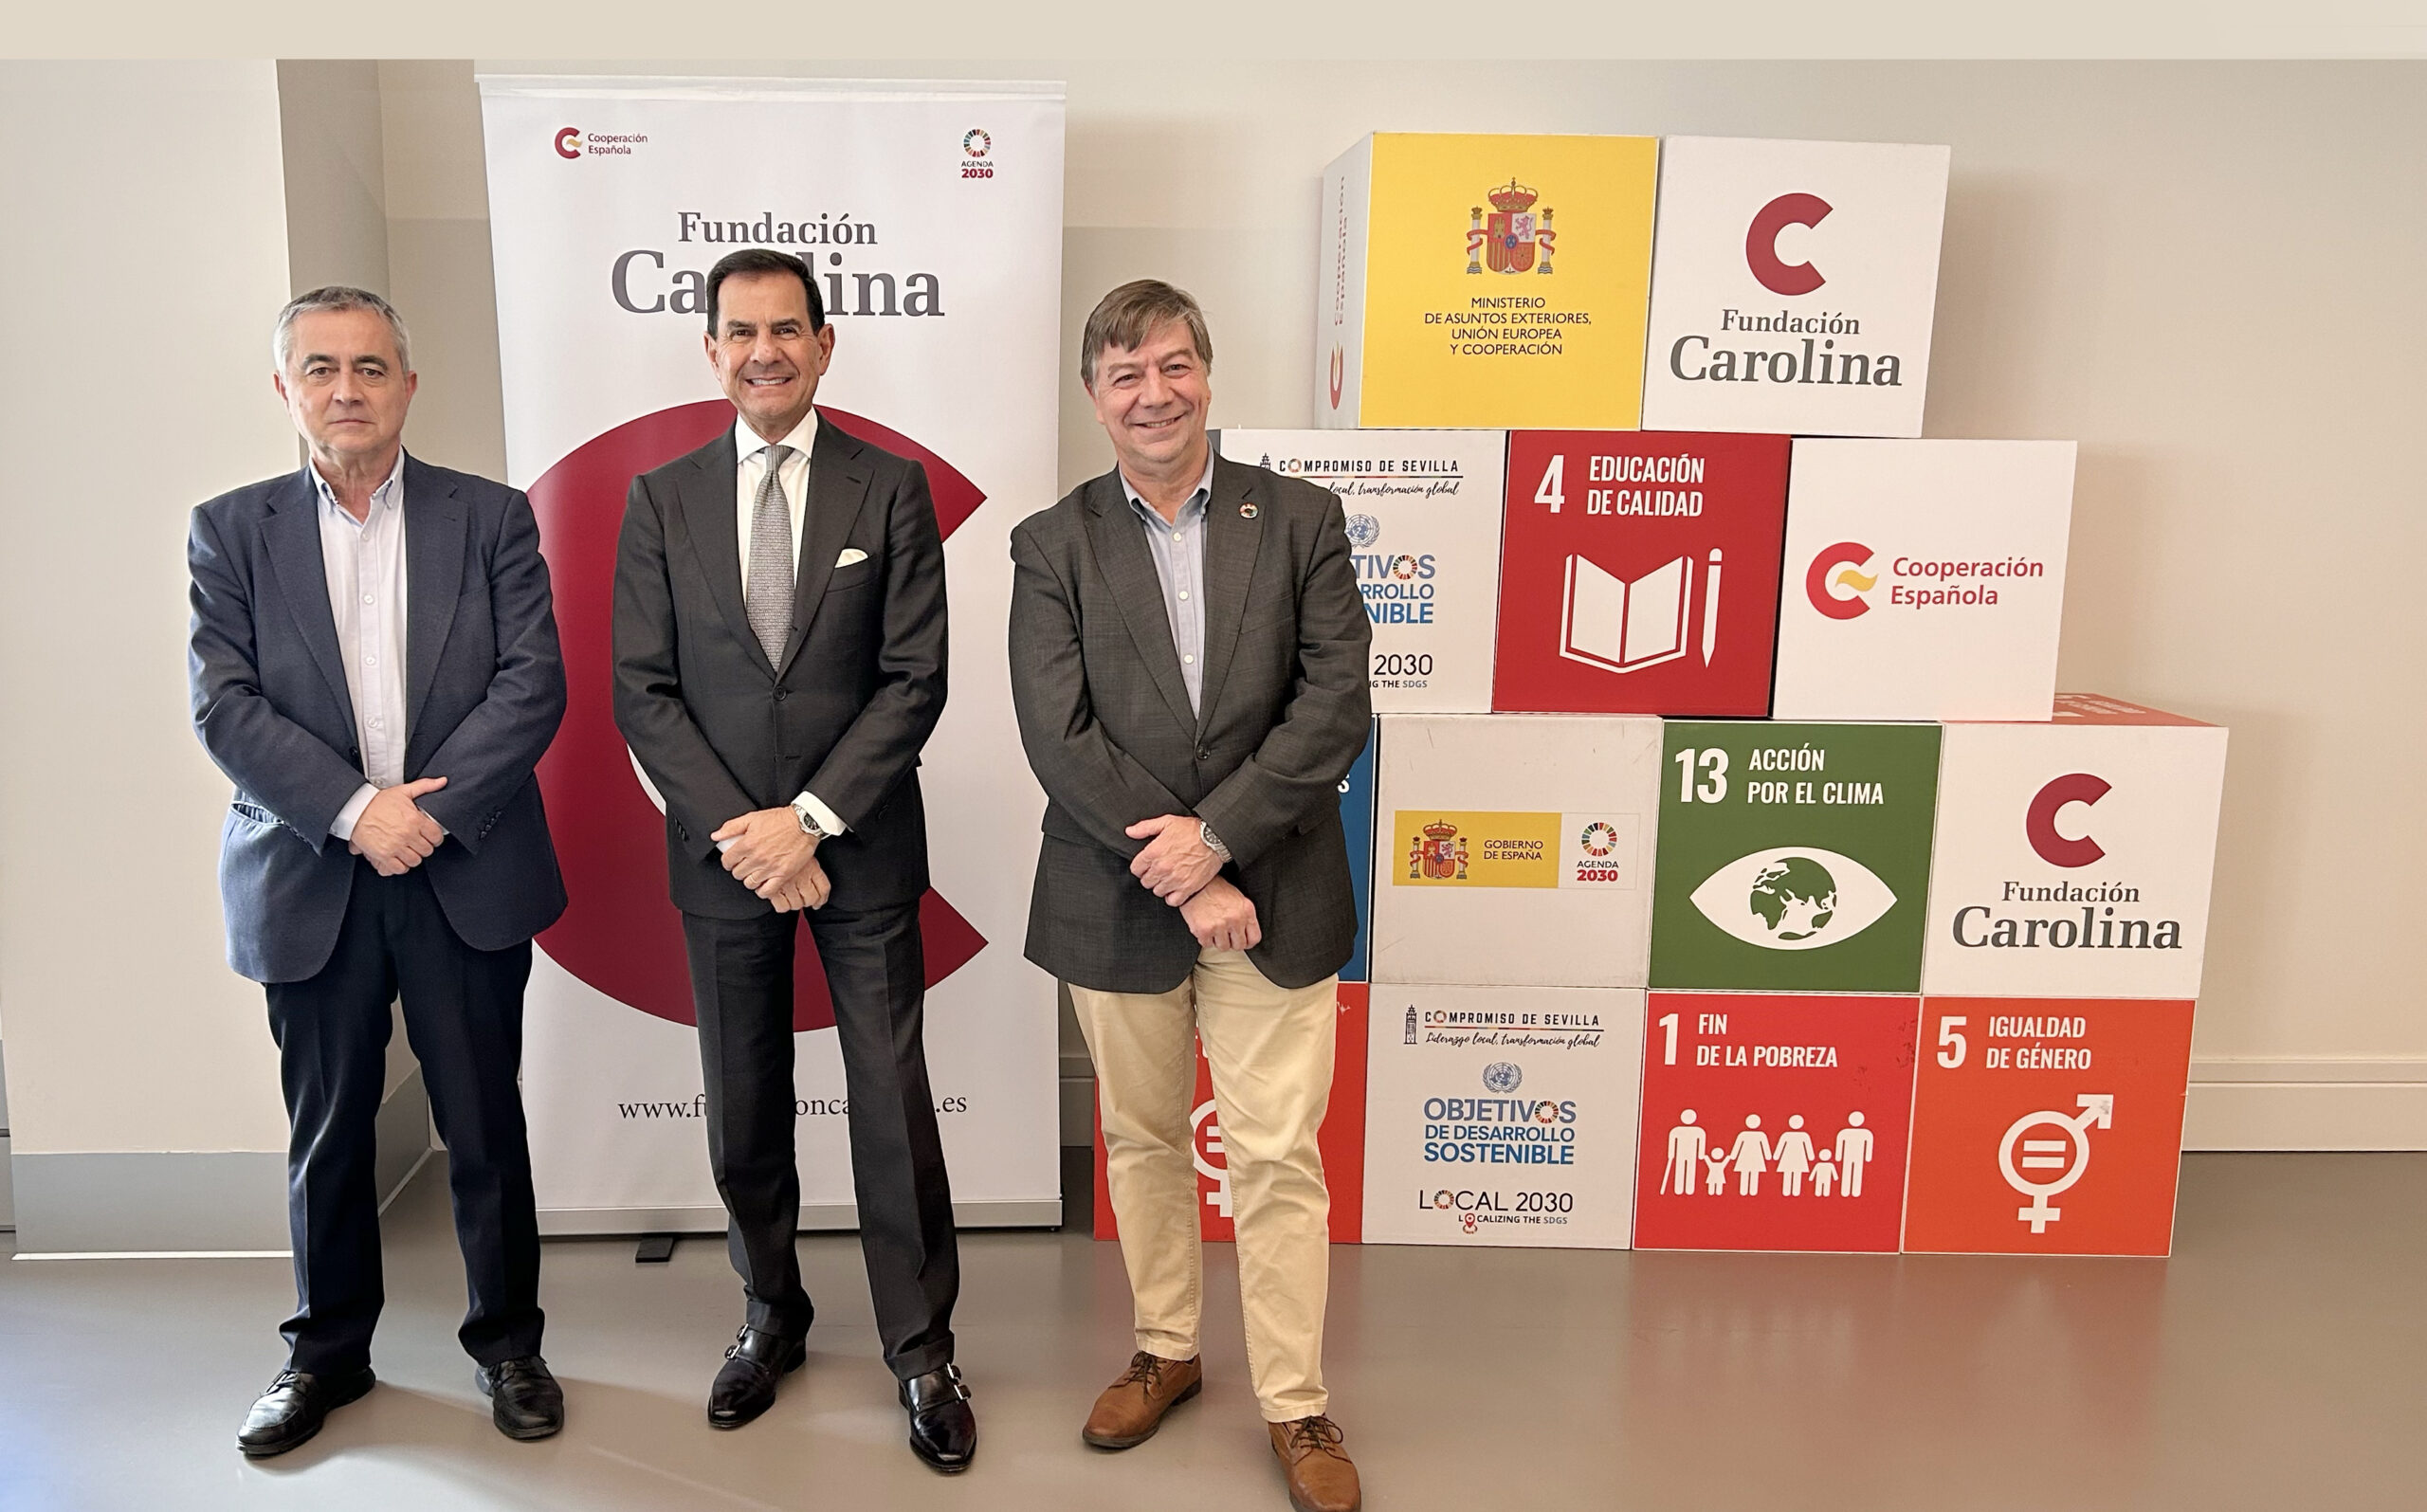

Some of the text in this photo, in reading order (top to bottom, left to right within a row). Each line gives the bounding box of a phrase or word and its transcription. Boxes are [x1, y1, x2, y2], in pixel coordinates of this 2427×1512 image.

[588, 133, 648, 144] Cooperación
[588, 145, 631, 156] Española
[961, 169, 994, 178] 2030
[678, 211, 878, 245] Fundación
[611, 249, 945, 317] Caina
[1470, 297, 1545, 309] MINISTERIO
[1424, 313, 1592, 325] DE ASUNTOS EXTERIORES,
[1721, 308, 1860, 335] Fundación
[1451, 326, 1562, 339] UNIÓN EUROPEA
[1450, 341, 1562, 355] Y COOPERACIÓN
[1670, 335, 1903, 387] Carolina
[1279, 458, 1458, 473] COMPROMISO DE SEVILLA
[1589, 453, 1706, 483] EDUCACIÓN
[1358, 482, 1424, 498] transformación
[1426, 482, 1460, 500] global
[1534, 454, 1565, 514] 4
[1586, 489, 1705, 517] DE CALIDAD
[1350, 555, 1436, 580] TIVOS
[1892, 556, 2044, 582] Cooperación
[1359, 583, 1434, 600] RROLLO
[1890, 584, 1998, 610] Española
[1362, 602, 1434, 624] NIBLE
[1374, 654, 1433, 676] 2030
[1381, 680, 1400, 688] THE
[1402, 680, 1428, 688] SDGS
[1748, 742, 1825, 772] ACCIÓN
[1674, 747, 1729, 804] 13
[1747, 781, 1885, 805] POR EL CLIMA
[1484, 839, 1543, 850] GOBIERNO
[1484, 848, 1542, 861] DE ESPAÑA
[1577, 860, 1619, 869] AGENDA
[1577, 869, 1618, 882] 2030
[2001, 881, 2140, 902] Fundación
[1952, 905, 2182, 950] Carolina
[1425, 1010, 1599, 1026] COMPROMISO DE SEVILLA
[1698, 1013, 1727, 1035] FIN
[1989, 1015, 2087, 1039] IGUALDAD
[1425, 1031, 1600, 1049] Liderazgo local, transformación global
[1658, 1012, 1680, 1066] 1
[1936, 1015, 1968, 1069] 5
[1696, 1046, 1838, 1068] DE LA POBREZA
[1985, 1043, 2092, 1070] DE GÉNERO
[1423, 1097, 1577, 1124] OBJETIVOS
[1425, 1124, 1576, 1142] DE DESARROLLO
[1424, 1141, 1575, 1165] SOSTENIBLE
[1419, 1190, 1574, 1213] LOCAL 2030
[1523, 1215, 1541, 1224] THE
[1542, 1216, 1568, 1225] SDGS
